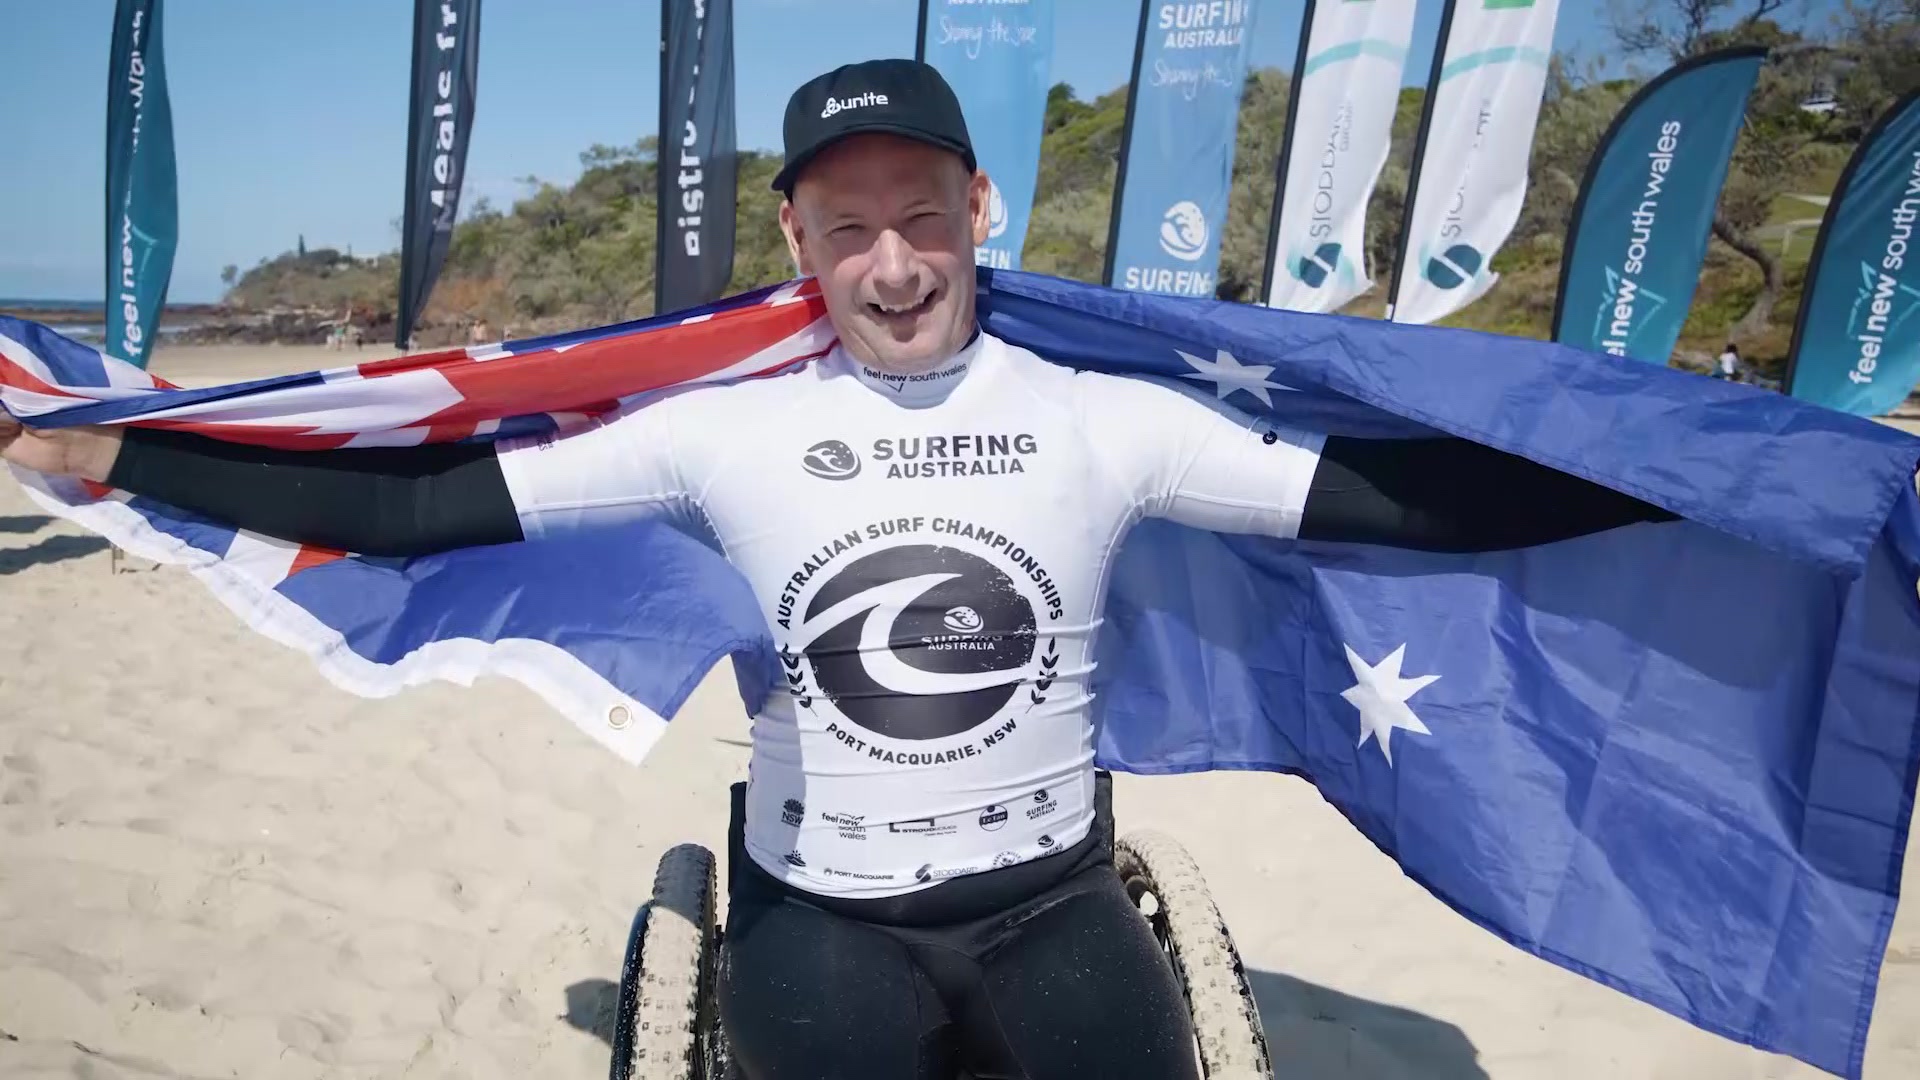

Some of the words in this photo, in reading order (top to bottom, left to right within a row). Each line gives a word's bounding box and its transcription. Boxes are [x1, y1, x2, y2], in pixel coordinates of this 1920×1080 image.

[841, 92, 889, 110] unite
[1610, 278, 1638, 336] new
[1624, 194, 1658, 274] south
[1644, 120, 1681, 197] wales
[1882, 198, 1920, 270] south
[122, 214, 135, 288] new
[1867, 273, 1898, 332] new
[120, 292, 143, 357] feel
[1849, 335, 1883, 385] feel
[863, 366, 881, 380] feel
[883, 372, 908, 383] new
[909, 371, 940, 382] south
[941, 362, 968, 379] wales
[872, 433, 1038, 461] SURFING
[886, 458, 1025, 479] AUSTRALIA
[777, 529, 863, 630] AUSTRALIAN
[866, 516, 925, 540] SURF
[931, 517, 1063, 621] CHAMPIONSHIPS
[928, 642, 995, 651] AUSTRALIA
[826, 722, 866, 752] PORT
[868, 744, 982, 765] MACQUARIE,
[983, 718, 1017, 748] NSW
[782, 811, 804, 825] NSW
[1026, 800, 1057, 817] SURFING
[1030, 807, 1056, 820] AUSTRALIA
[822, 813, 838, 823] feel
[839, 818, 860, 826] new
[839, 831, 867, 841] wales
[834, 870, 852, 878] PORT
